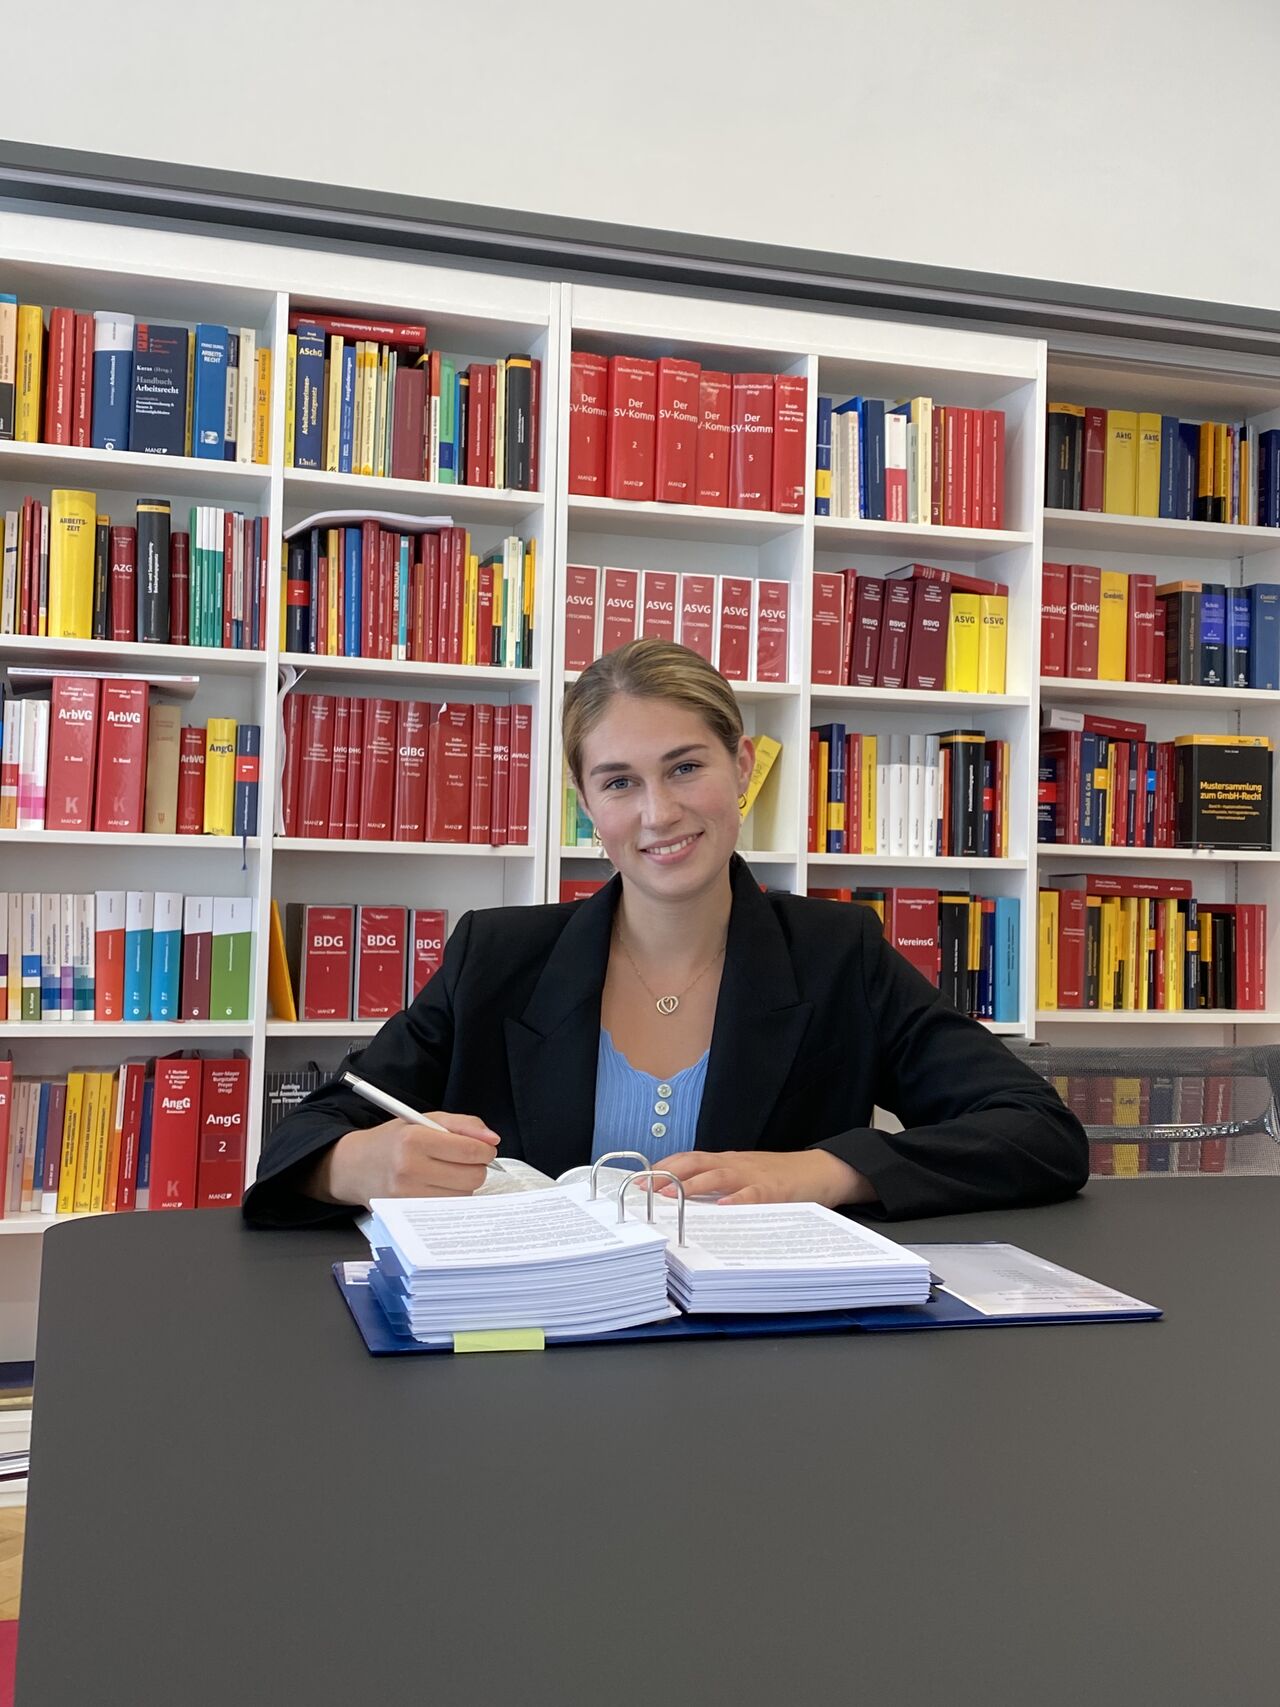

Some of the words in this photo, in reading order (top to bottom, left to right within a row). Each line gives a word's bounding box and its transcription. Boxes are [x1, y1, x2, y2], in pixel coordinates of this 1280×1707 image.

[202, 350, 223, 358] ARBEITS-
[299, 347, 323, 357] ASchG
[136, 376, 172, 385] Handbuch
[135, 384, 179, 394] Arbeitsrecht
[581, 394, 596, 404] Der
[628, 399, 644, 408] Der
[674, 400, 688, 410] Der
[614, 409, 655, 422] SV-Komm
[659, 410, 698, 423] SV-Komm
[705, 411, 720, 420] Der
[744, 413, 760, 422] Der
[731, 425, 773, 433] SV-Komm
[1116, 432, 1132, 440] AktG
[1144, 433, 1159, 442] AktG
[632, 441, 637, 449] 2
[748, 454, 754, 462] 5
[59, 518, 88, 526] ARBEITS-
[113, 564, 133, 573] AZG
[567, 595, 594, 606] ASVG
[1103, 592, 1124, 600] GmbHG
[607, 598, 634, 609] ASVG
[646, 600, 673, 611] ASVG
[1071, 602, 1099, 614] GmbHG
[684, 604, 711, 614] ASVG
[723, 606, 749, 617] ASVG
[760, 609, 786, 619] ASVG
[862, 617, 878, 627] BSVG
[889, 619, 906, 629] BSVG
[922, 619, 939, 628] BSVG
[954, 616, 975, 624] ASVG
[58, 709, 93, 721] ArbVG
[107, 711, 141, 723] ArbVG
[209, 744, 233, 753] AngG
[400, 747, 425, 757] GlBG
[493, 745, 509, 753] BPG
[181, 755, 204, 764] ArbVG
[493, 753, 508, 761] PKG
[1200, 782, 1262, 792] Mustersammlung
[1217, 792, 1262, 802] GmbH-Recht
[314, 935, 344, 947] BDG
[367, 935, 396, 946] BDG
[416, 939, 441, 949] BDG
[898, 938, 934, 946] VereinsG
[162, 1097, 191, 1110] AngG
[206, 1114, 241, 1127] AngG
[218, 1141, 226, 1152] 2
